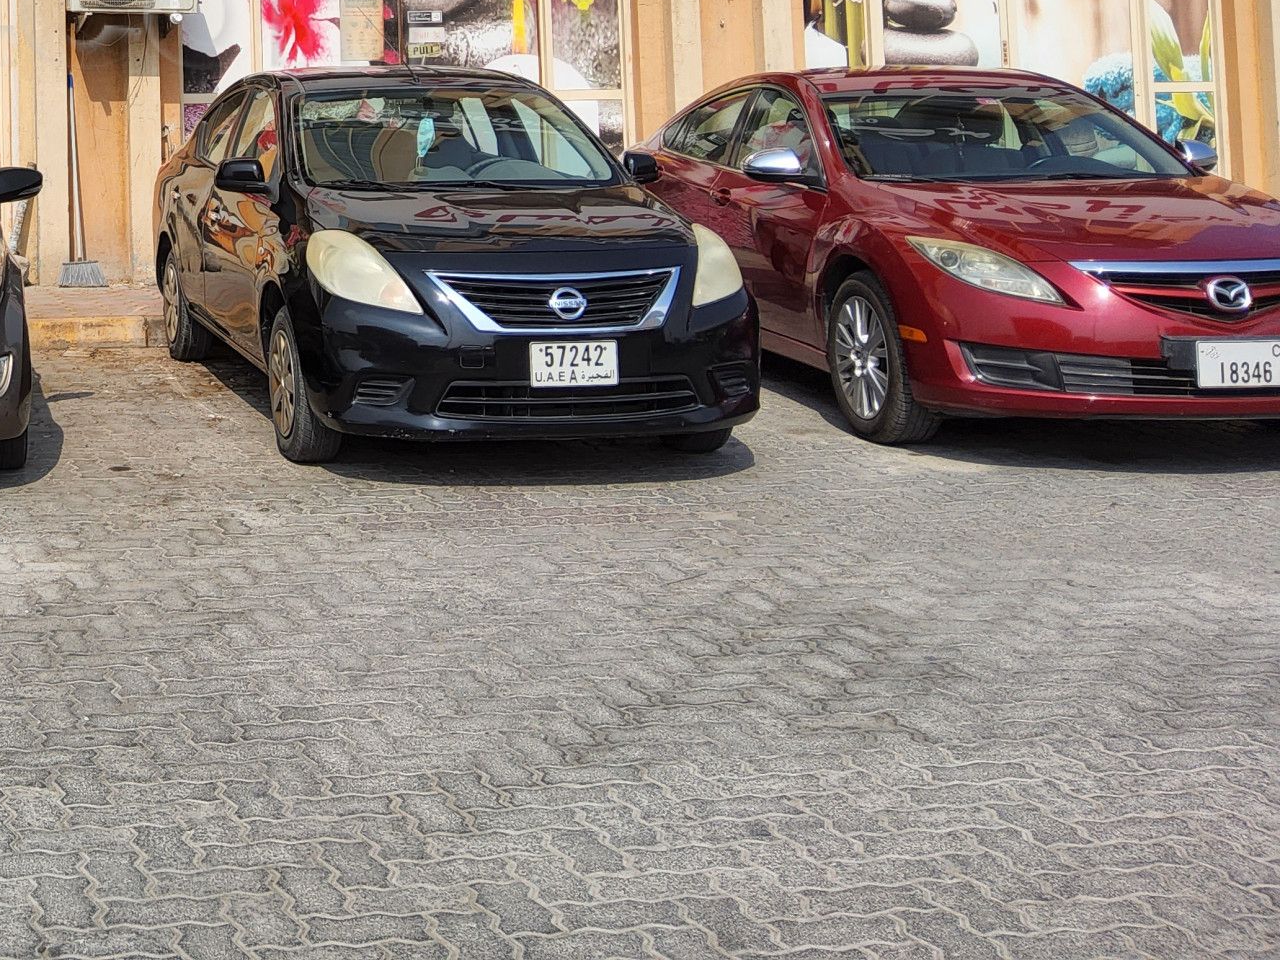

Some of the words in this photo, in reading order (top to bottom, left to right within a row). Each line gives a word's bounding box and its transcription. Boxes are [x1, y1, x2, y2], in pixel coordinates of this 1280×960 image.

[544, 344, 604, 368] 57242
[569, 369, 578, 383] A
[1220, 361, 1273, 384] 18346
